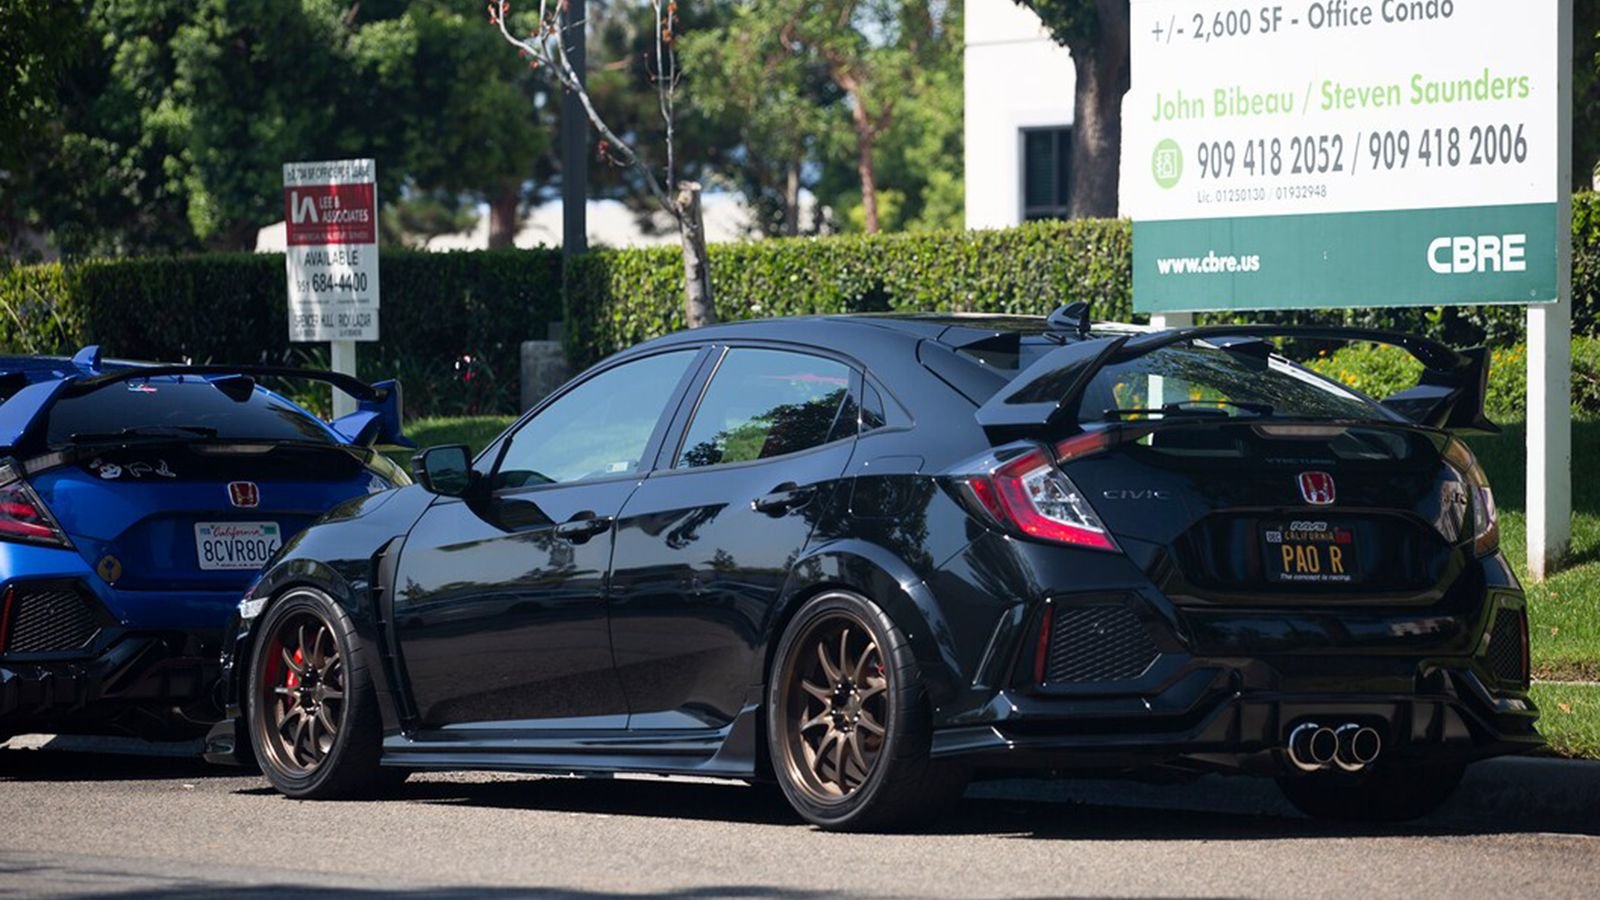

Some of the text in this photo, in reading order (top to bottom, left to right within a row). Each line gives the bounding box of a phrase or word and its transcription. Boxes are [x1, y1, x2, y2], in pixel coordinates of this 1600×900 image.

[1152, 15, 1184, 44] +/-
[1192, 9, 1251, 43] 2,600
[1259, 6, 1283, 34] SF
[1307, 0, 1373, 29] Office
[1381, 0, 1454, 23] Condo
[1152, 93, 1205, 122] John
[1213, 86, 1294, 117] Bibeau
[1320, 80, 1401, 111] Steven
[1410, 68, 1530, 105] Saunders
[1198, 140, 1236, 179] 909
[1243, 136, 1282, 177] 418
[1290, 134, 1344, 174] 2052
[1368, 129, 1410, 170] 909
[1418, 126, 1460, 167] 418
[1469, 123, 1528, 165] 2006
[1275, 184, 1327, 200] 01932948
[322, 208, 369, 223] ASSOCIATES
[304, 250, 359, 266] AVAILABLE
[1157, 250, 1260, 275] www.cbre.us
[1427, 233, 1526, 274] CBRE
[312, 273, 368, 293] 684-4400
[1103, 489, 1170, 500] CIVIC
[213, 526, 261, 539] California
[1284, 531, 1335, 541] CALIFORNIA
[203, 539, 276, 562] 8CVR806
[1329, 545, 1344, 573] R
